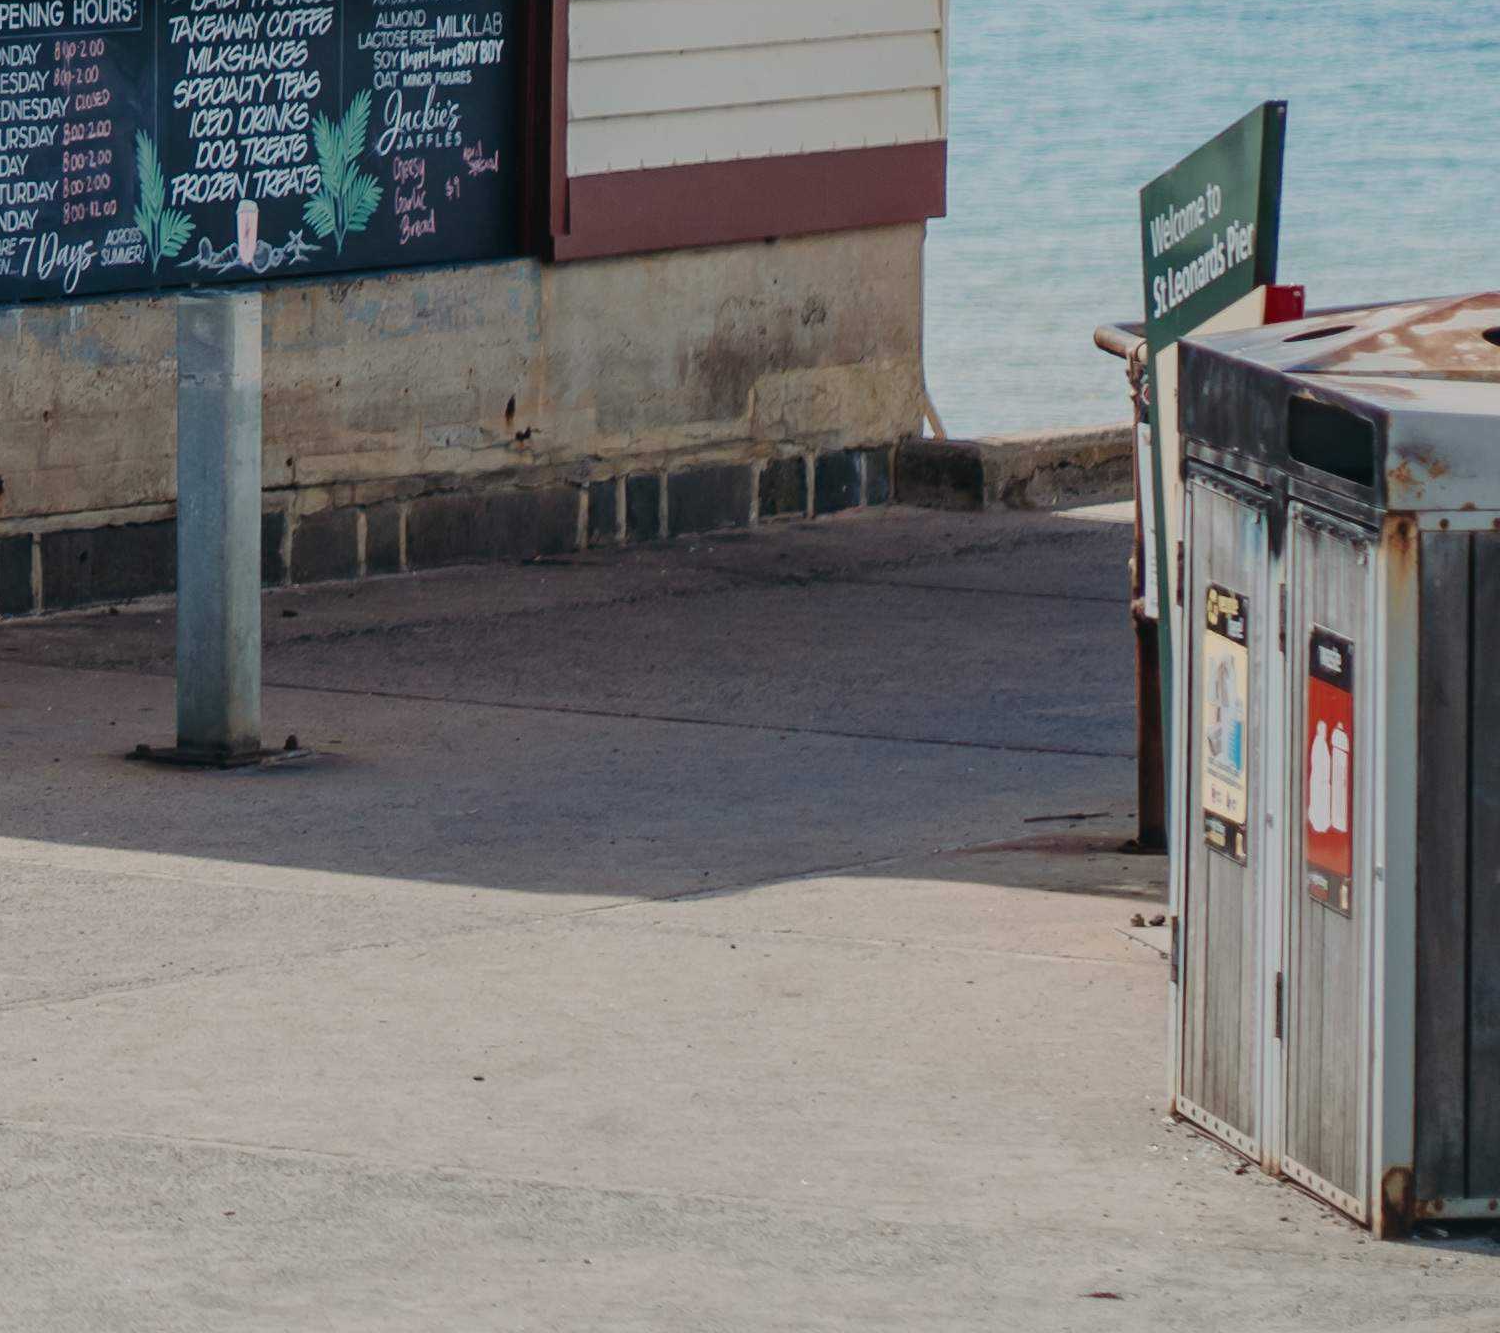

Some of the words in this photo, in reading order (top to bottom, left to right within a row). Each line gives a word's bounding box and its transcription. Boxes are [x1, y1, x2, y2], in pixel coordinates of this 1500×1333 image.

[168, 11, 266, 45] TAKEAWAY
[266, 6, 335, 38] COFFEE
[375, 9, 427, 29] ALMOND
[185, 39, 310, 75] MILKSHAKES
[358, 29, 409, 50] LACTOSE
[409, 28, 436, 48] FREE
[373, 50, 400, 71] SOY
[457, 40, 480, 67] SOY
[480, 39, 504, 65] BOY
[172, 73, 274, 110] SPECIALTY
[274, 70, 322, 101] TEAS
[373, 70, 399, 91] OAT
[402, 72, 432, 87] MINOR
[435, 69, 473, 86] FIGURES
[75, 88, 111, 111] CLOSED
[189, 107, 234, 139] ICED
[236, 102, 310, 135] DRINKS
[376, 84, 462, 157] Jackie's
[195, 138, 240, 170] DOG
[240, 132, 309, 166] TREATS
[396, 131, 462, 151] JAFFLES
[171, 171, 251, 206] FROZEN
[252, 163, 322, 199] TREATS
[104, 227, 143, 246] ACROSS
[398, 208, 437, 245] Bread
[1149, 194, 1206, 258] Welcome
[1206, 182, 1222, 219] to
[19, 237, 36, 278] 7
[37, 232, 98, 294] Days
[100, 244, 148, 267] SUMMER!
[1152, 273, 1169, 319] St
[1167, 232, 1227, 309] Leonards
[1226, 219, 1255, 269] Pier
